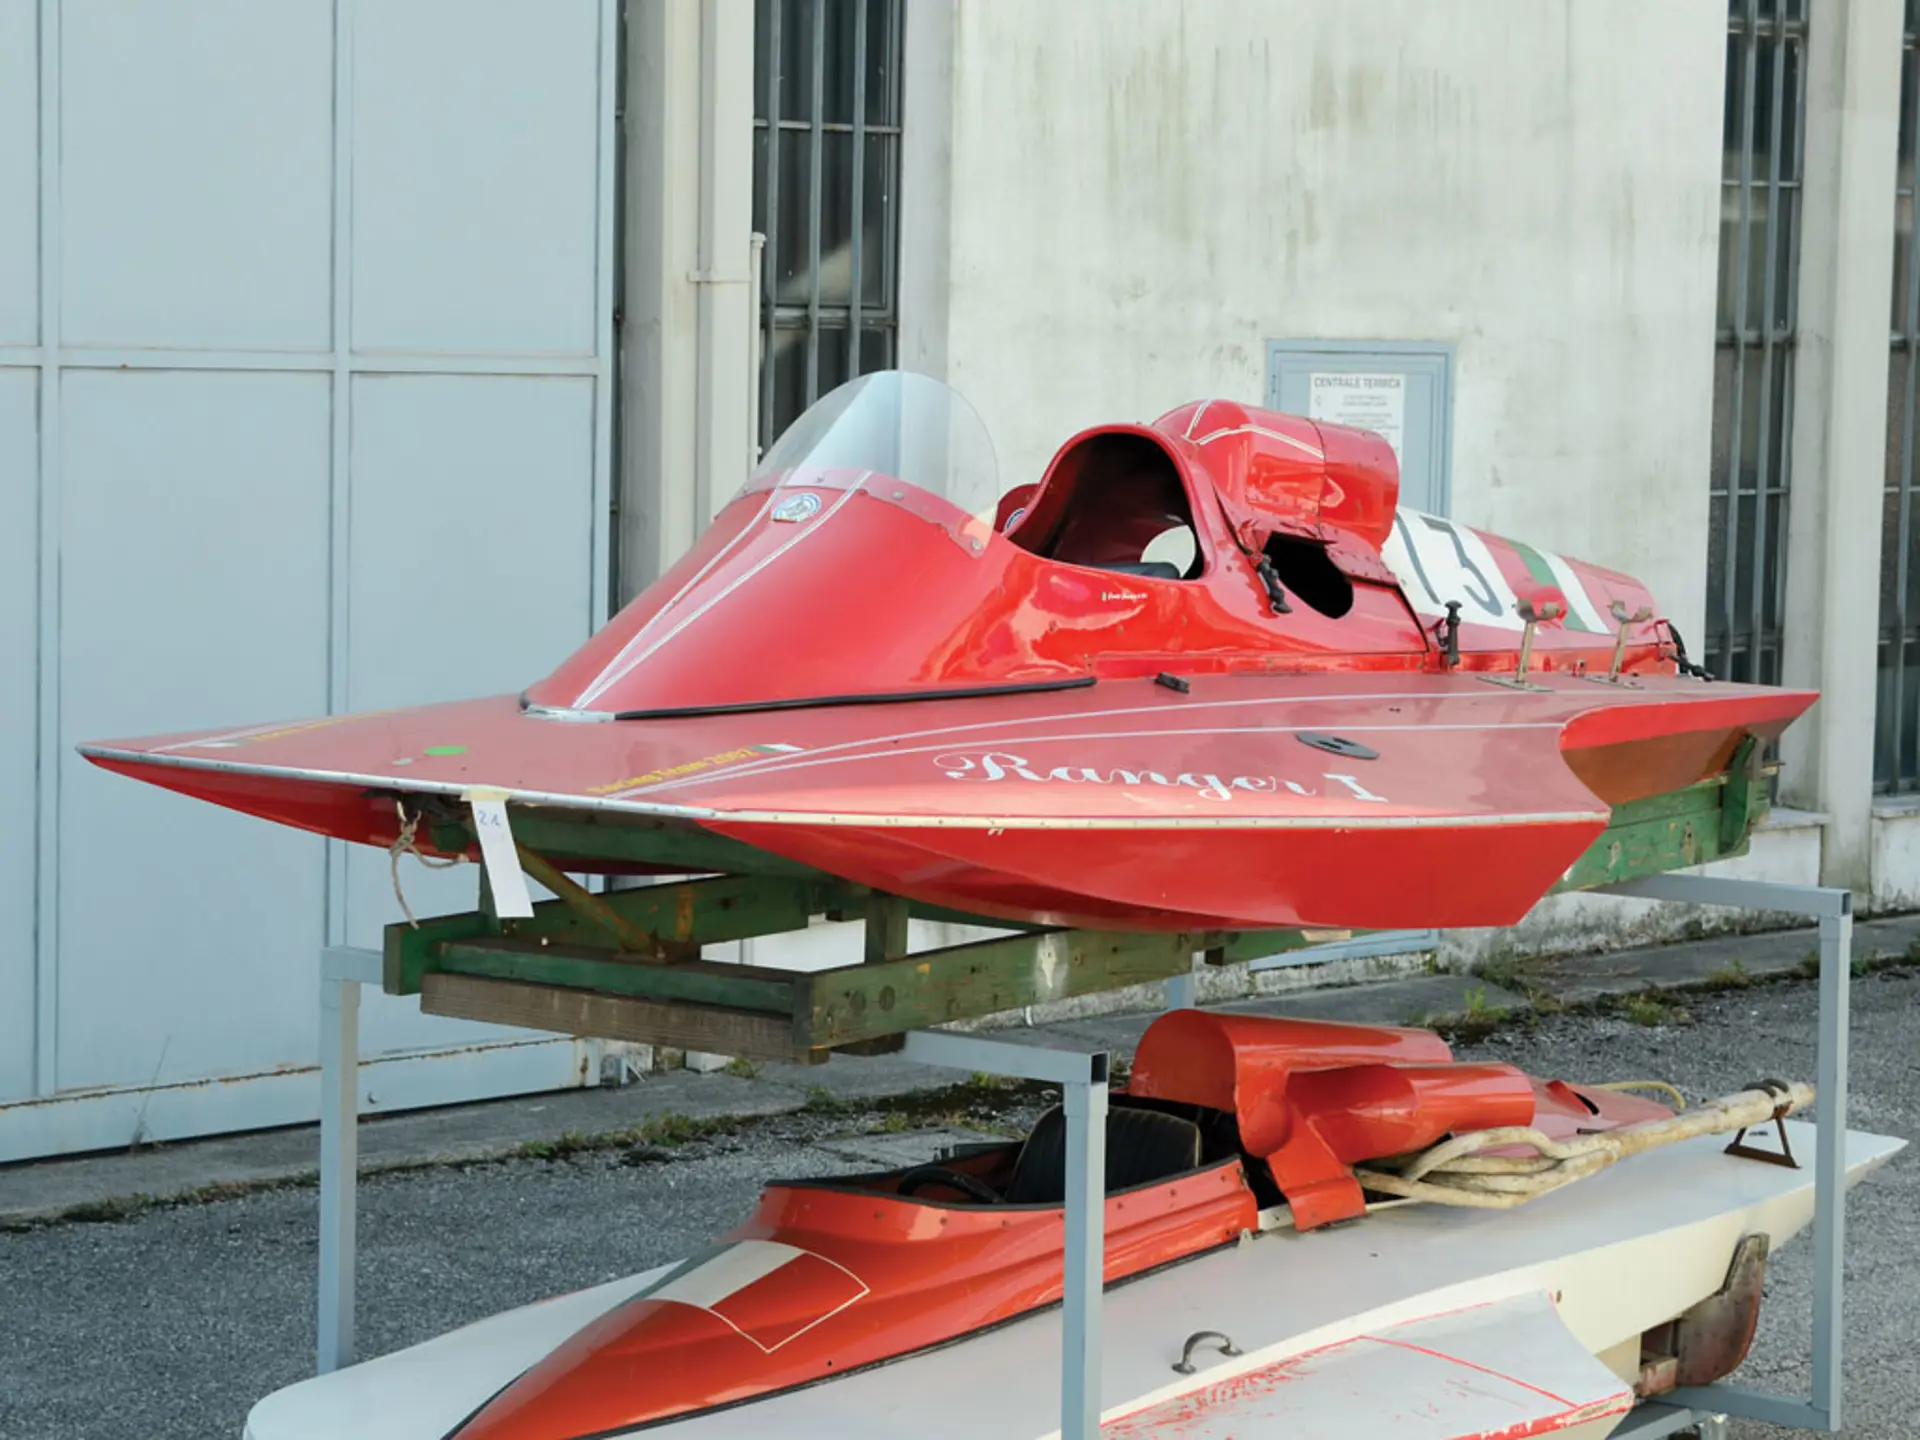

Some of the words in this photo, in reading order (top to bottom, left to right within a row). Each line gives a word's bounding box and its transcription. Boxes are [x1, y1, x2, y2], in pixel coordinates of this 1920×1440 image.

[1314, 376, 1361, 389] CENTRALE
[1363, 377, 1400, 390] TERMICA
[933, 751, 1316, 801] Ranger
